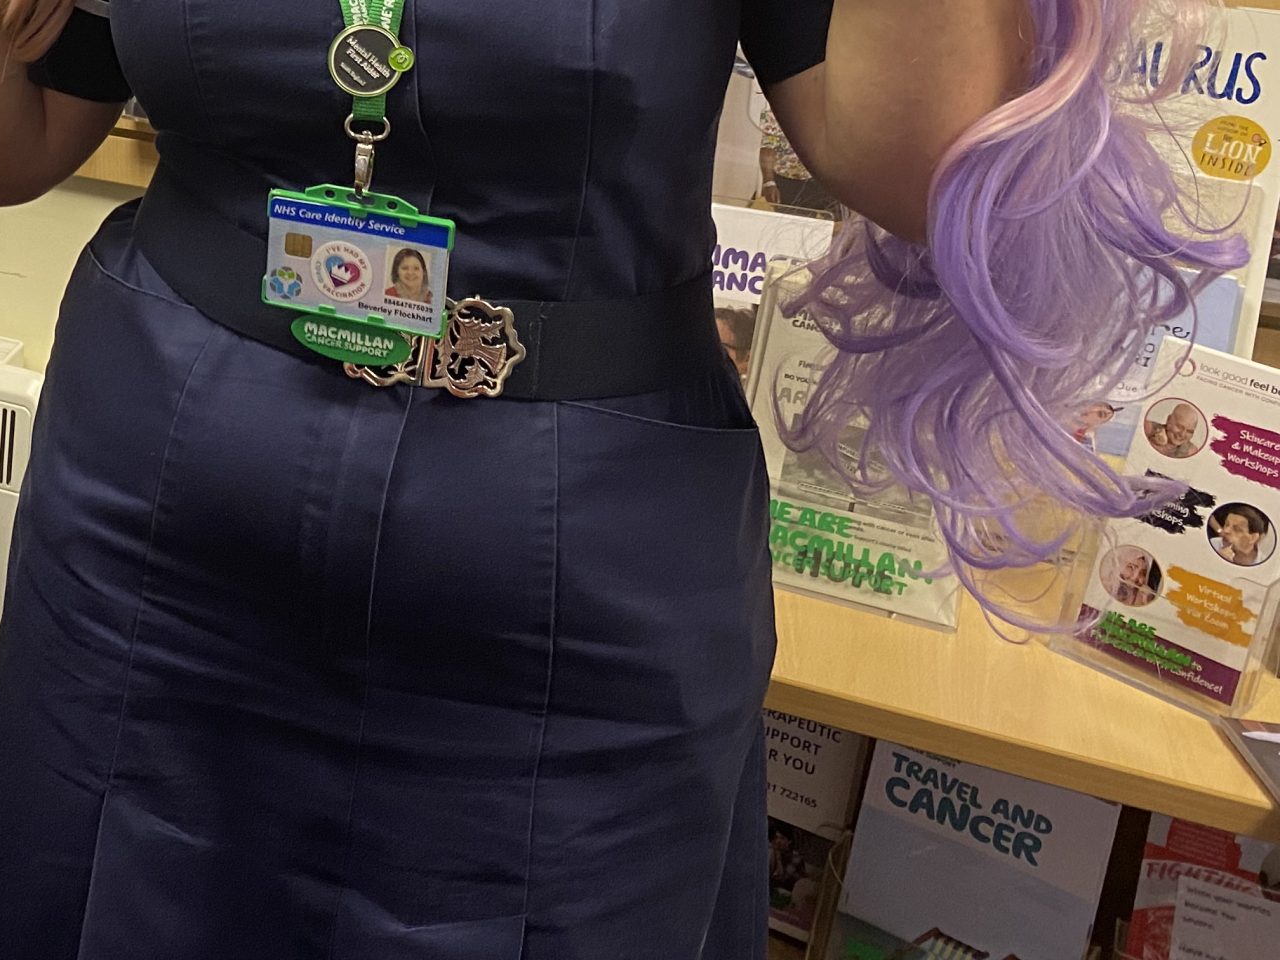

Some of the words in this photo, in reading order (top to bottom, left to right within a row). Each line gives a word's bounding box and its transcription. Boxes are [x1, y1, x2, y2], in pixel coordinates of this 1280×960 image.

[345, 47, 362, 64] First
[360, 60, 381, 79] Aider
[346, 35, 373, 61] Mental
[369, 54, 391, 79] Health
[274, 204, 296, 216] NHS
[298, 208, 323, 221] Care
[324, 212, 366, 230] Identity
[368, 220, 406, 235] Service
[358, 301, 392, 316] Beverley
[394, 309, 433, 323] Flockhart
[304, 321, 394, 350] MACMILLAN
[305, 333, 342, 348] CANCER
[344, 341, 389, 358] SUPPORT
[1200, 362, 1220, 375] look
[1222, 371, 1248, 384] good
[1249, 378, 1269, 391] feel
[1231, 441, 1241, 450] &
[1227, 452, 1279, 478] Workshops
[799, 507, 854, 538] ARE
[821, 560, 908, 596] SUPPORT
[1198, 584, 1232, 604] Virtual
[1192, 661, 1202, 672] to
[783, 753, 816, 775] YOU
[892, 751, 983, 809] TRAVEL
[991, 797, 1053, 834] AND
[885, 776, 1042, 867] CANCER
